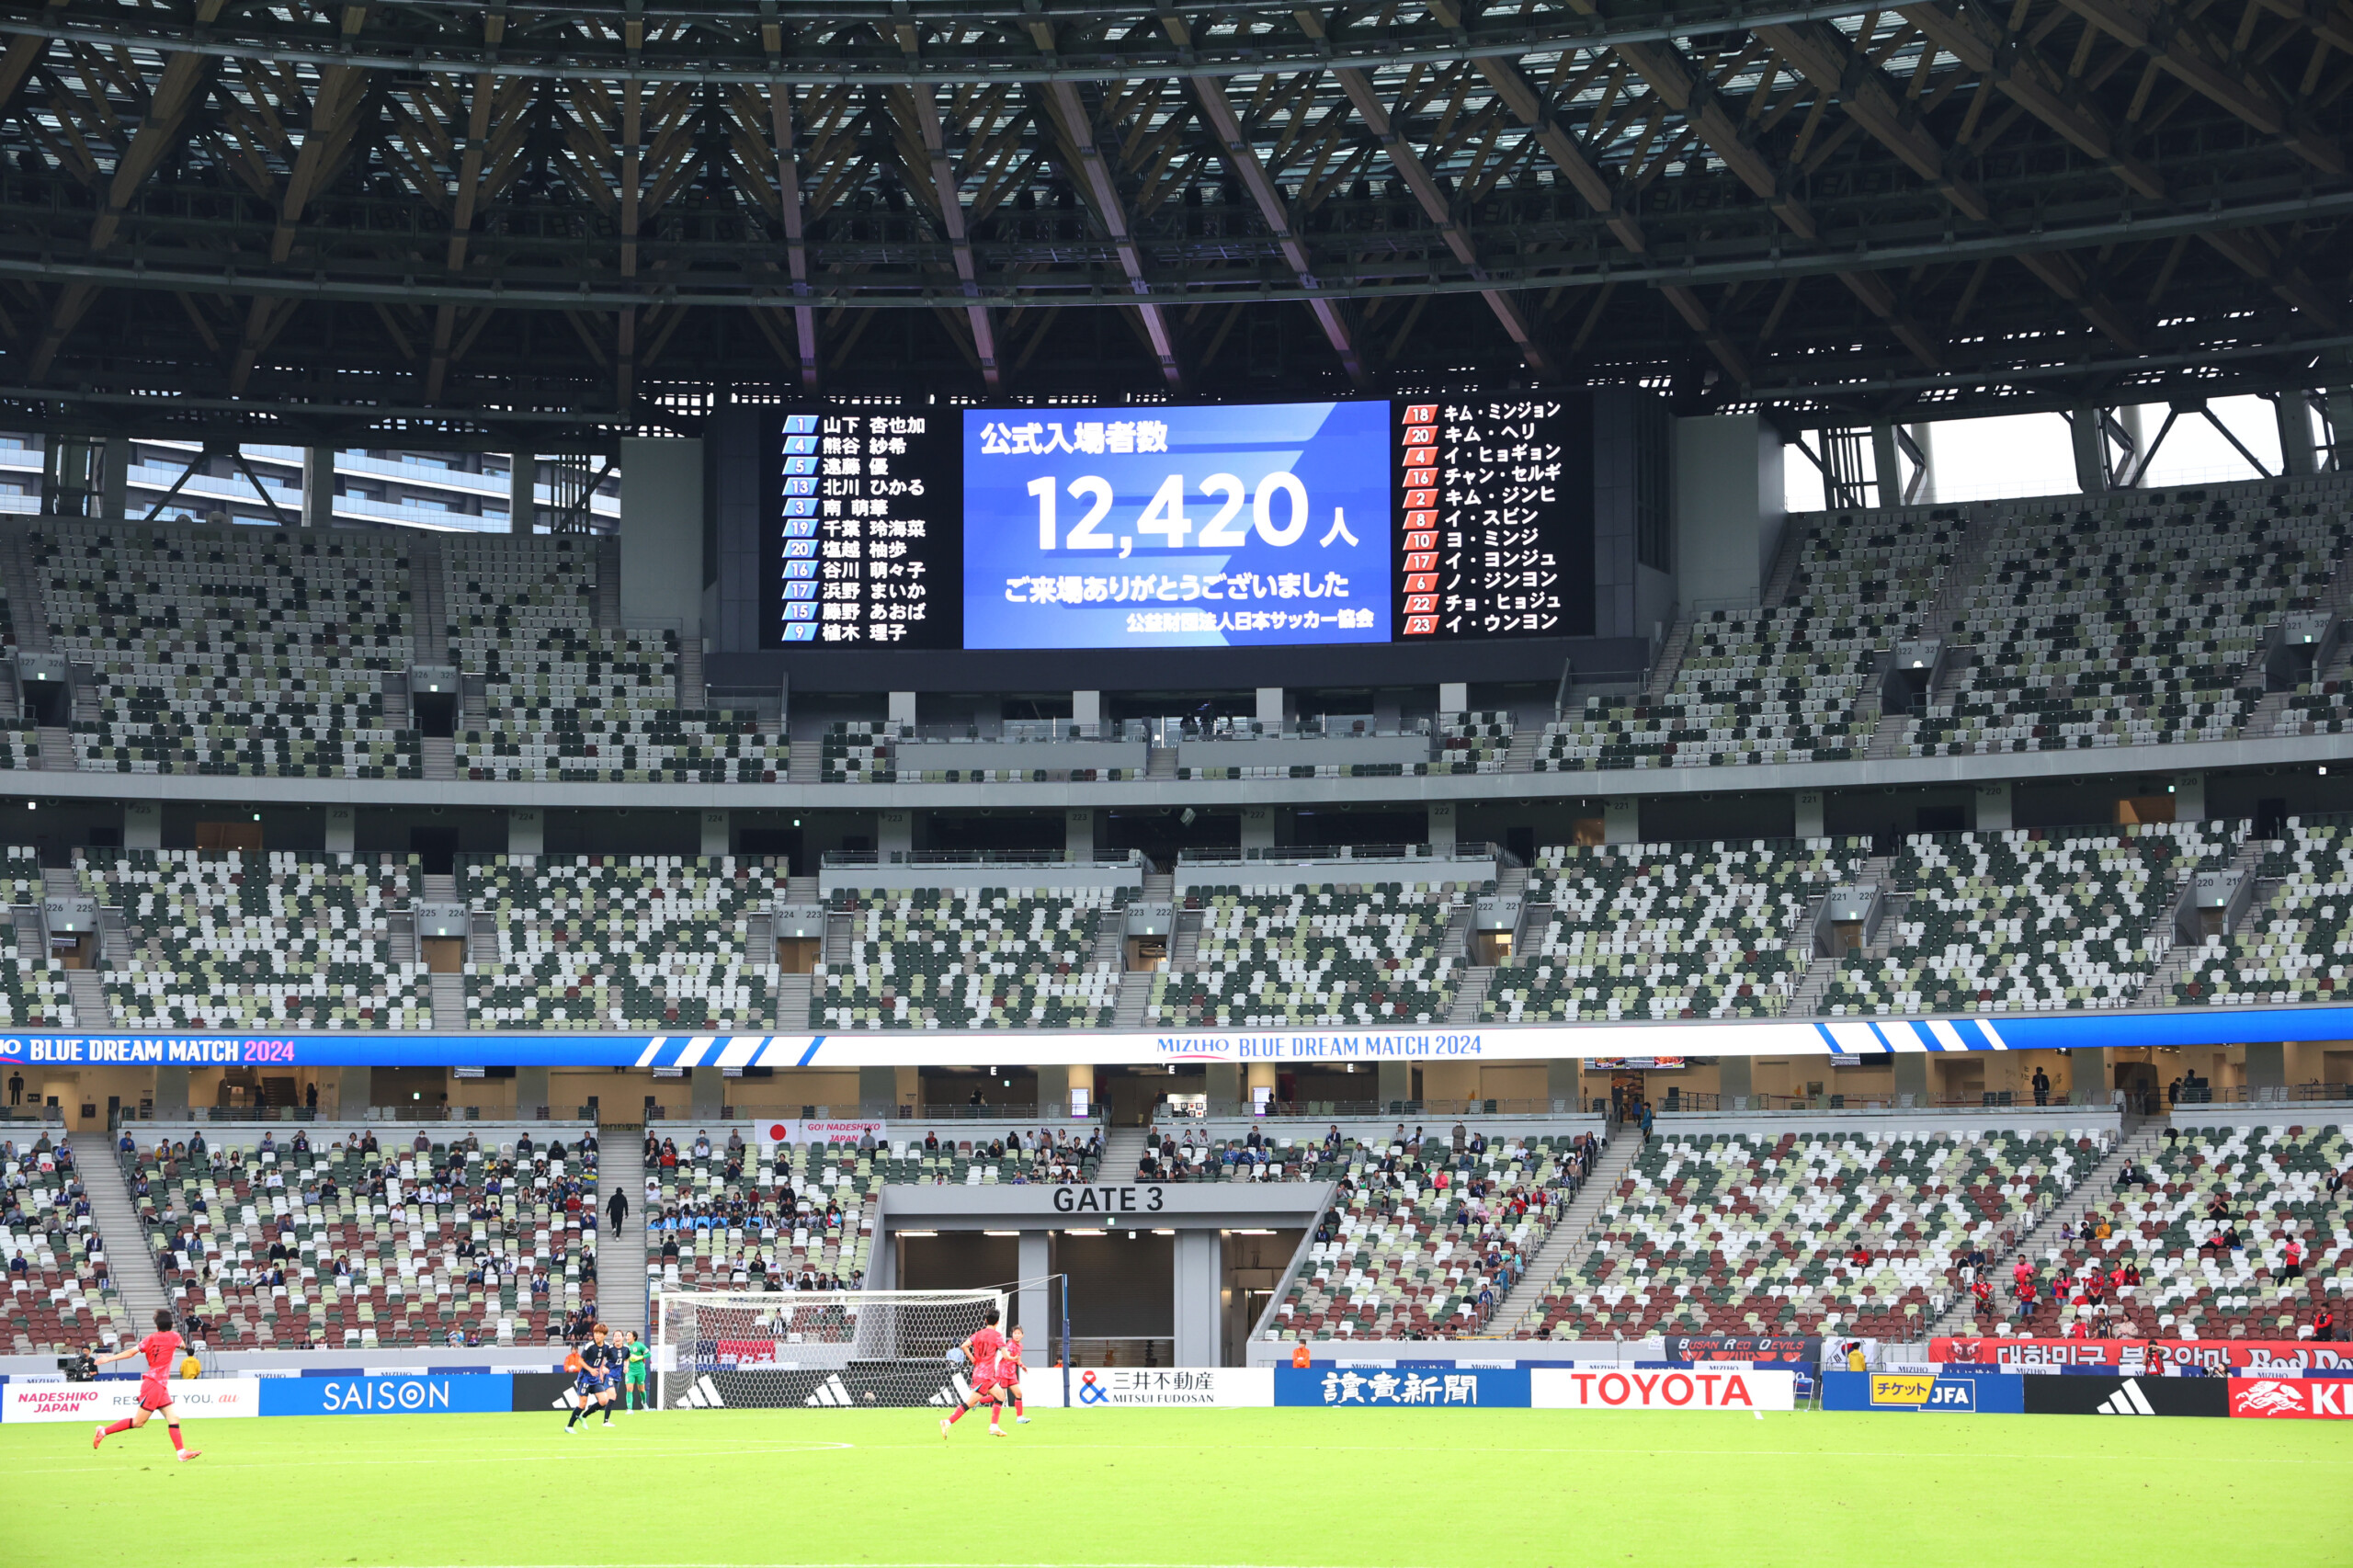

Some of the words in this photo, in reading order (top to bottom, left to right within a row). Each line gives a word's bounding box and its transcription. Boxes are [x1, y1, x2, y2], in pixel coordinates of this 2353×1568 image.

[1413, 408, 1429, 422] 18
[1444, 402, 1561, 422] キム・ミンジョン
[798, 418, 804, 431] 1
[824, 416, 859, 433] 山下
[870, 416, 925, 434] 杏也加
[1413, 429, 1429, 443] 20
[1445, 423, 1535, 443] キム・ヘリ
[980, 420, 1168, 454] 公式入場者数
[795, 438, 804, 451] 4
[823, 437, 860, 454] 熊谷
[870, 437, 906, 454] 紗希
[1415, 450, 1426, 464] 4
[1444, 444, 1561, 464] イ・ヒョギョン
[795, 460, 804, 472] 5
[823, 458, 860, 475] 遠藤
[870, 458, 888, 475] 優
[1413, 471, 1429, 484] 16
[1444, 463, 1562, 485] チャン・セルギ
[791, 480, 809, 493] 13
[824, 479, 858, 495] 北川
[870, 479, 924, 495] ひかる
[1416, 492, 1426, 506] 2
[1446, 486, 1555, 506] キム・ジンヒ
[795, 501, 804, 514] 3
[823, 499, 841, 517] 南
[851, 499, 888, 517] 萌華
[1028, 472, 1308, 558] 12,420
[1416, 513, 1426, 527] 8
[1446, 507, 1538, 527] イ・スビン
[791, 522, 809, 535] 19
[823, 520, 860, 537] 千葉
[870, 520, 926, 537] 玲海菜
[1414, 534, 1430, 548] 10
[1448, 528, 1538, 547] ヨ・ミンジ
[791, 542, 809, 555] 20
[823, 540, 860, 558] 塩越
[870, 540, 906, 558] 柚歩
[1414, 555, 1430, 569] 17
[1446, 550, 1555, 569] イ・ヨンジュ
[791, 563, 809, 576] 16
[823, 562, 858, 578] 谷川
[870, 562, 926, 579] 萌々子
[1005, 572, 1349, 604] ご来場ありがとうございました
[1416, 576, 1427, 590] 6
[1447, 572, 1557, 590] ノ・ジンヨン
[791, 584, 809, 597] 17
[823, 582, 860, 599] 浜野
[871, 583, 926, 599] まいか
[1414, 597, 1430, 611] 22
[1446, 592, 1560, 611] チョ・ヒョジュ
[791, 605, 809, 618] 15
[823, 603, 860, 620] 藤野
[870, 603, 926, 619] あおば
[1126, 608, 1374, 632] 公益財団法人日本サッカー協会
[1414, 619, 1430, 632] 23
[1446, 614, 1557, 632] イ・ウンヨン
[2286, 621, 2302, 630] 321
[795, 626, 804, 639] 9
[823, 623, 860, 641] 植木
[870, 624, 906, 641] 理子
[1897, 646, 1913, 654] 322
[20, 659, 35, 667] 327
[48, 659, 63, 667] 326
[414, 671, 429, 679] 326
[439, 671, 455, 679] 325
[2181, 778, 2197, 786] 220
[1802, 795, 1817, 803] 221
[1985, 787, 2001, 795] 220
[135, 806, 151, 814] 225
[1434, 808, 1449, 816] 222
[1614, 801, 1629, 810] 221
[333, 810, 347, 818] 225
[518, 812, 533, 821] 224
[708, 814, 722, 823] 224
[888, 814, 903, 823] 223
[1073, 812, 1087, 821] 223
[1250, 811, 1265, 819] 222
[2197, 879, 2213, 888] 220
[1831, 892, 1847, 902] 221
[1859, 892, 1874, 901] 220
[47, 903, 63, 912] 226
[76, 903, 93, 913] 225
[420, 909, 436, 917] 225
[449, 909, 464, 917] 224
[779, 911, 794, 919] 224
[805, 911, 822, 919] 223
[1129, 908, 1144, 916] 223
[1155, 908, 1172, 916] 222
[1477, 903, 1494, 911] 222
[1506, 903, 1520, 911] 221
[29, 1040, 84, 1061] BLUE
[88, 1040, 163, 1062] DREAM
[168, 1040, 239, 1062] MATCH
[244, 1040, 295, 1062] 2024
[1157, 1038, 1230, 1053] MIZUHO
[1239, 1038, 1285, 1057] BLUE
[1292, 1037, 1358, 1057] DREAM
[1366, 1036, 1429, 1056] MATCH
[1436, 1035, 1483, 1055] 2024
[1053, 1187, 1137, 1212] GATE
[1146, 1187, 1164, 1211] 3
[1113, 1371, 1214, 1391] 三井不動産
[1571, 1372, 1753, 1406] TOYOTA
[1877, 1382, 1927, 1396] チケット
[17, 1392, 98, 1403] NADESHIKO
[184, 1394, 213, 1403] YOU.
[218, 1394, 239, 1403] au
[323, 1381, 449, 1411] SAISON
[1113, 1394, 1154, 1403] MITSUI
[1158, 1394, 1214, 1403] FUDOSAN
[1931, 1387, 1969, 1403] JFA
[33, 1403, 80, 1414] JAPAN
